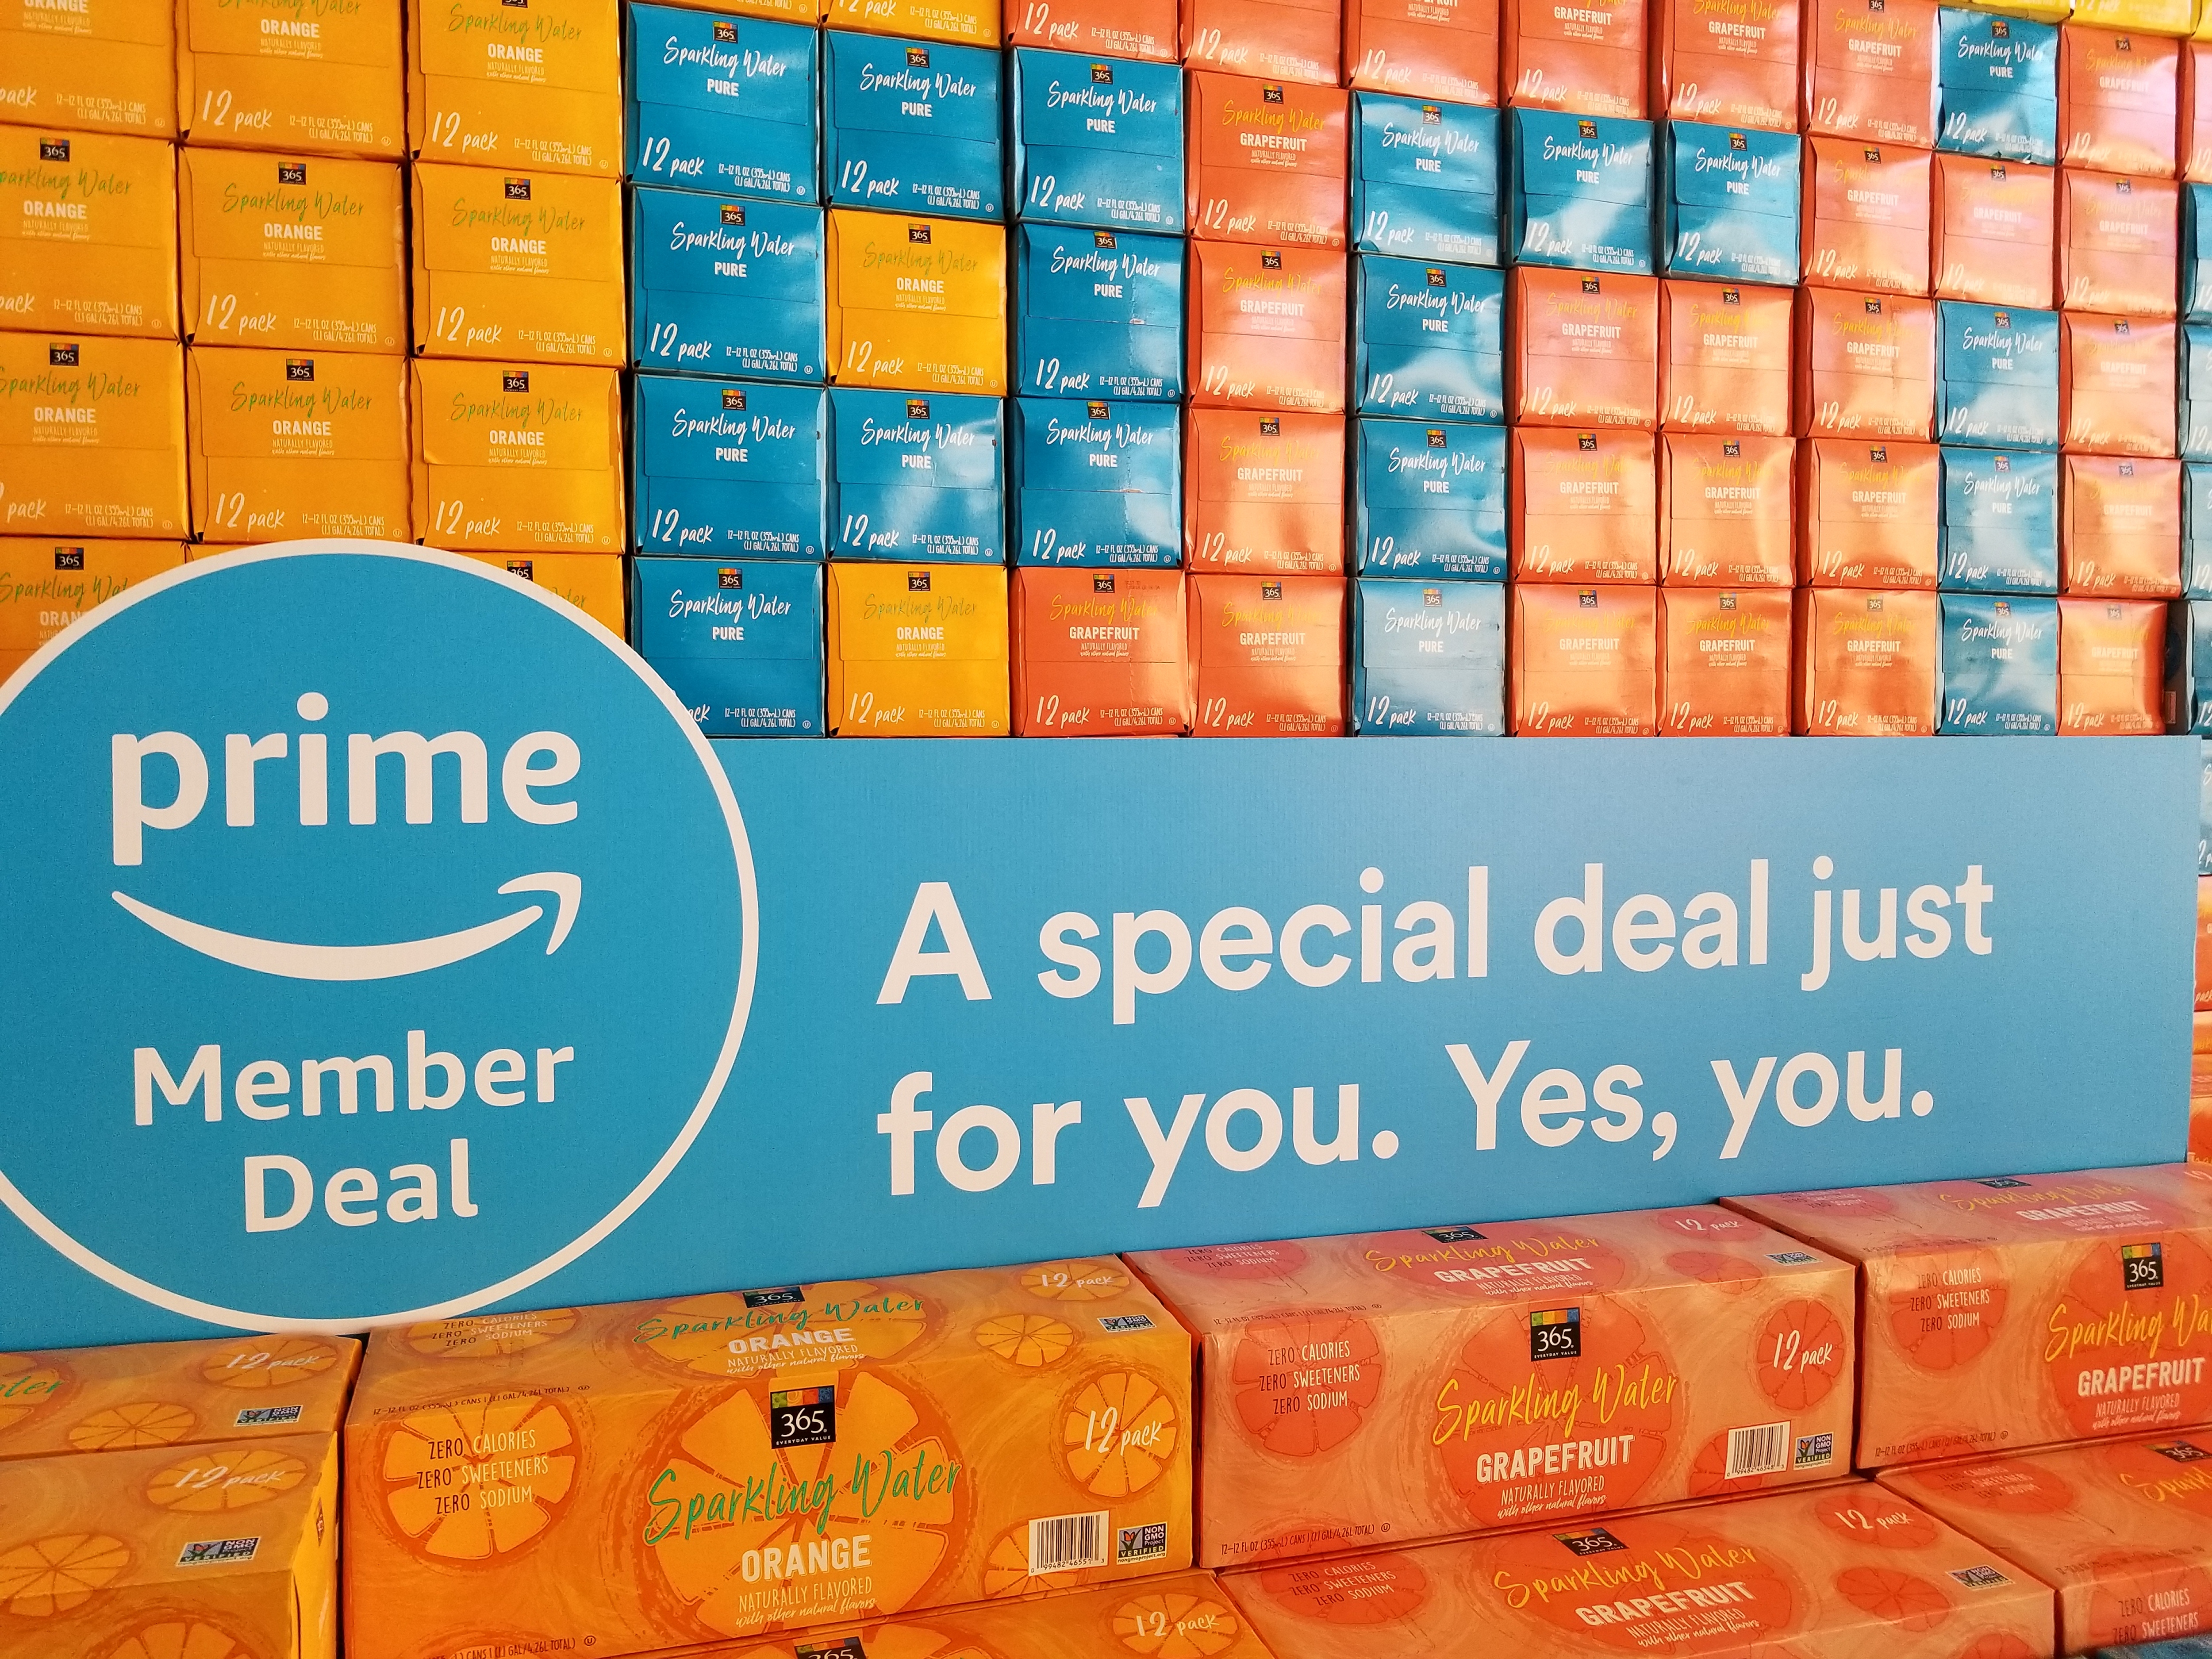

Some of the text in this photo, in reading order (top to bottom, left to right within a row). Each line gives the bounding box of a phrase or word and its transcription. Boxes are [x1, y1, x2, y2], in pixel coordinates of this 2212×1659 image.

[717, 28, 734, 39] 365
[664, 36, 786, 78] Sparkling Water
[707, 78, 739, 97] PURE
[1094, 71, 1110, 81] 365
[1047, 80, 1156, 116] Sparkling Water
[1266, 91, 1281, 101] 365
[1087, 119, 1115, 133] PURE
[1222, 100, 1284, 133] Sparkling
[1240, 133, 1307, 151] GRAPEFRUIT
[642, 137, 704, 177] 12 pack
[1030, 175, 1085, 212] 12 pack
[1204, 199, 1256, 232] 12 pack
[896, 277, 944, 294] ORANGE
[290, 367, 311, 377] 365
[507, 378, 526, 389] 365
[231, 381, 372, 418] Sparkling Water
[273, 420, 332, 436] ORANGE
[489, 430, 544, 446] ORANGE
[1388, 447, 1448, 480] Sparkling
[1424, 480, 1449, 494] PURE
[216, 492, 285, 531] 12 pack
[435, 500, 500, 536] 12 pack
[1371, 536, 1420, 567] 12 pack
[1069, 626, 1139, 641] GRAPEFRUIT
[1991, 648, 2013, 660] PURE
[1036, 695, 1090, 729] 12 pack
[112, 692, 581, 865] prime
[876, 855, 1994, 1025] A special deal just
[134, 1030, 573, 1125] Member
[876, 1040, 1935, 1209] for you. Yes, you.
[243, 1138, 478, 1233] Deal
[1674, 1218, 1742, 1231] 12 pack
[1365, 1237, 1600, 1271] Sparkling Water
[1042, 1272, 1114, 1287] 12 pack
[1434, 1258, 1593, 1283] GRAPEFRUIT
[1943, 1268, 1981, 1285] CALORIES
[2129, 1260, 2158, 1283] 365
[1910, 1289, 1990, 1311] ZERO SWEETENERS
[634, 1297, 924, 1344] Sparkling Water
[1920, 1312, 1980, 1332] ZERO SODIUM
[2045, 1301, 2164, 1363] Sparkling
[728, 1328, 856, 1354] ORANGE
[1538, 1326, 1574, 1351] 365
[1774, 1330, 1833, 1373] 12 pack
[227, 1352, 319, 1369] 12 pack
[728, 1344, 858, 1368] NATURALLY FLAVORED
[1268, 1340, 1350, 1366] ZERO CALORIES
[1259, 1364, 1360, 1391] ZERO SWEETENERS
[2078, 1357, 2205, 1397] GRAPEFRUIT
[1273, 1391, 1348, 1415] ZERO SODIUM
[1432, 1364, 1677, 1445] Sparkling Water
[781, 1408, 827, 1437] 365
[1085, 1407, 1161, 1455] 12 pack
[427, 1430, 536, 1459] ZERO CALORIES
[776, 1437, 809, 1446] EVERYDAY
[1476, 1434, 1635, 1483] GRAPEFRUIT
[1797, 1454, 1831, 1463] VERIFIED
[175, 1466, 285, 1489] 12 pack
[416, 1456, 548, 1489] ZERO SWEETENERS
[434, 1486, 532, 1514] ZERO SODIUM
[644, 1450, 961, 1544] Sparkling Water
[1501, 1475, 1605, 1506] NATURALLY FLAVORED
[1834, 1509, 1913, 1530] 12 pack
[1144, 1532, 1164, 1540] GMO
[1241, 1541, 1248, 1552] FL
[1250, 1541, 1258, 1551] OZ
[1290, 1533, 1306, 1545] CANS
[1572, 1536, 1616, 1551] 365
[741, 1535, 872, 1582] ORANGE
[1121, 1545, 1164, 1556] VERIFIED
[1494, 1546, 1756, 1609] Sparkling Water
[739, 1577, 872, 1613] NATURALLY FLAVORED
[1575, 1582, 1757, 1626] GRAPEFRUIT
[736, 1596, 877, 1628] with other natural flavors
[1136, 1611, 1220, 1636] 12 pack
